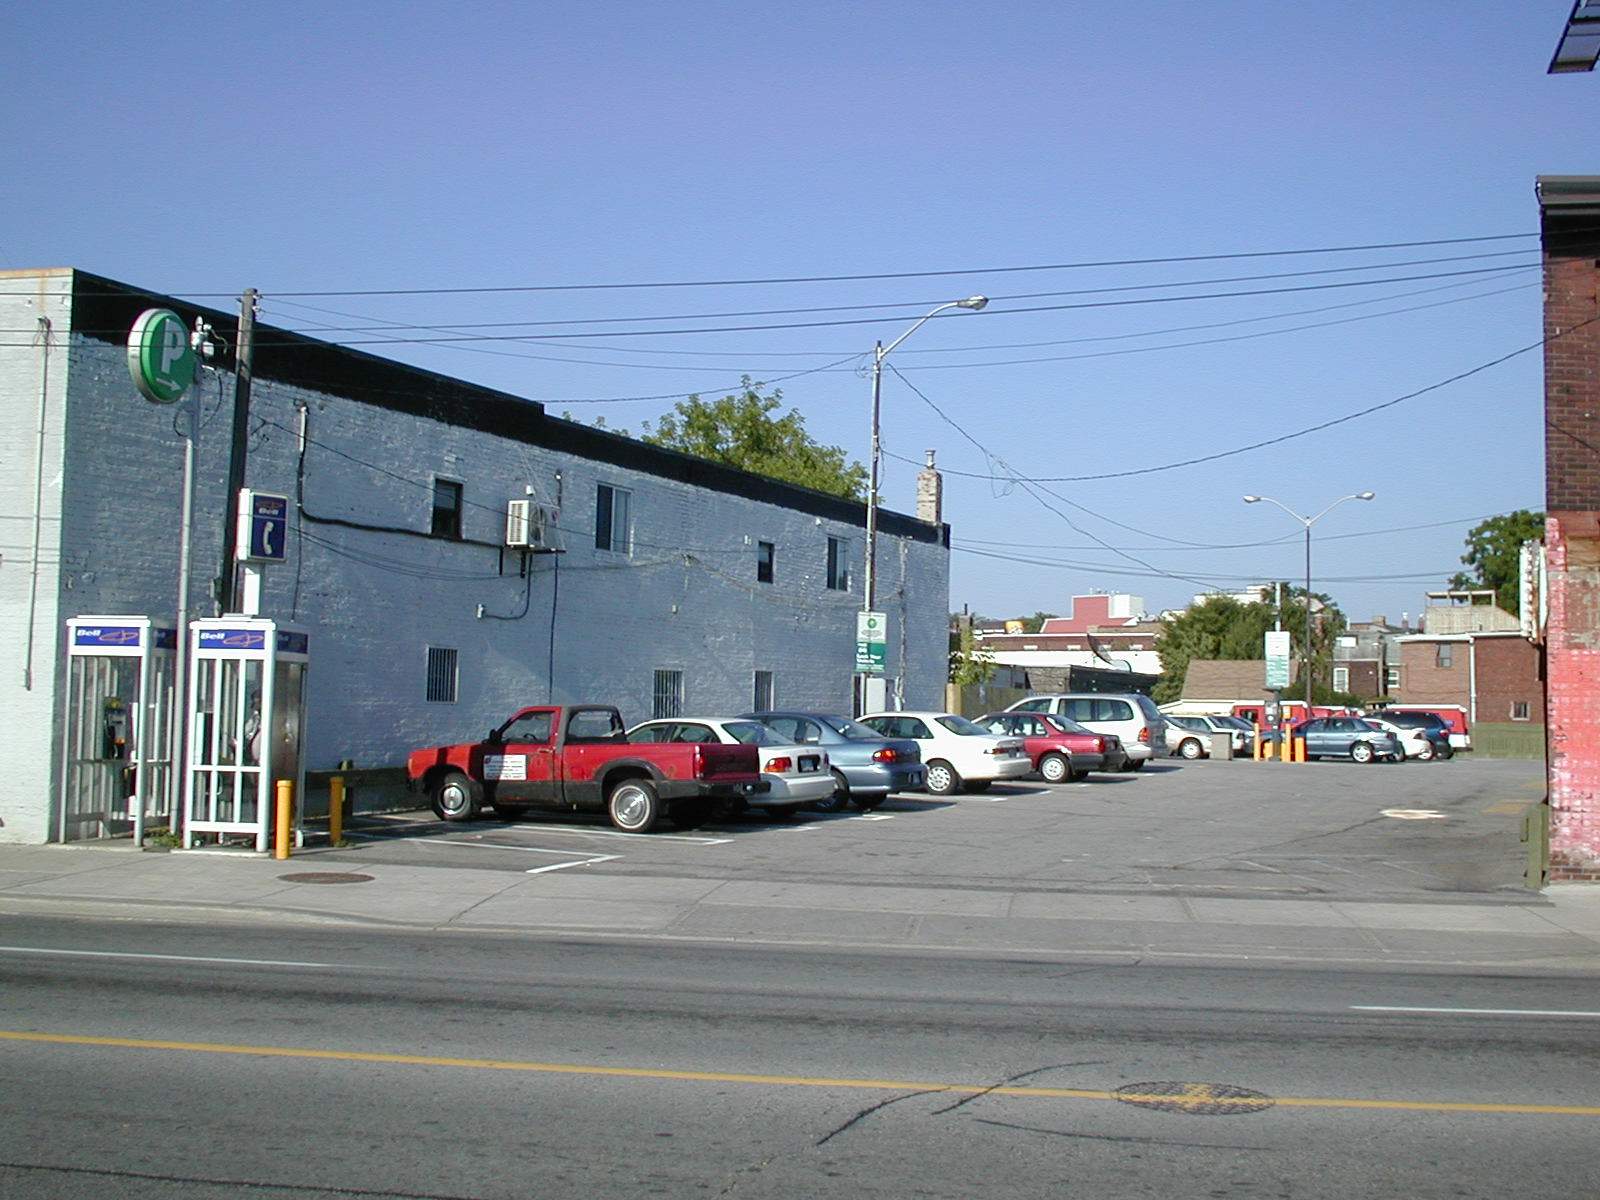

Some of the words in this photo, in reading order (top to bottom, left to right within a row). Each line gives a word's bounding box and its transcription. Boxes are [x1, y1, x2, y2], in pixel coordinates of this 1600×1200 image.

[161, 318, 187, 374] P
[258, 507, 279, 516] Bell
[77, 629, 101, 637] Bell
[200, 632, 225, 640] Bell
